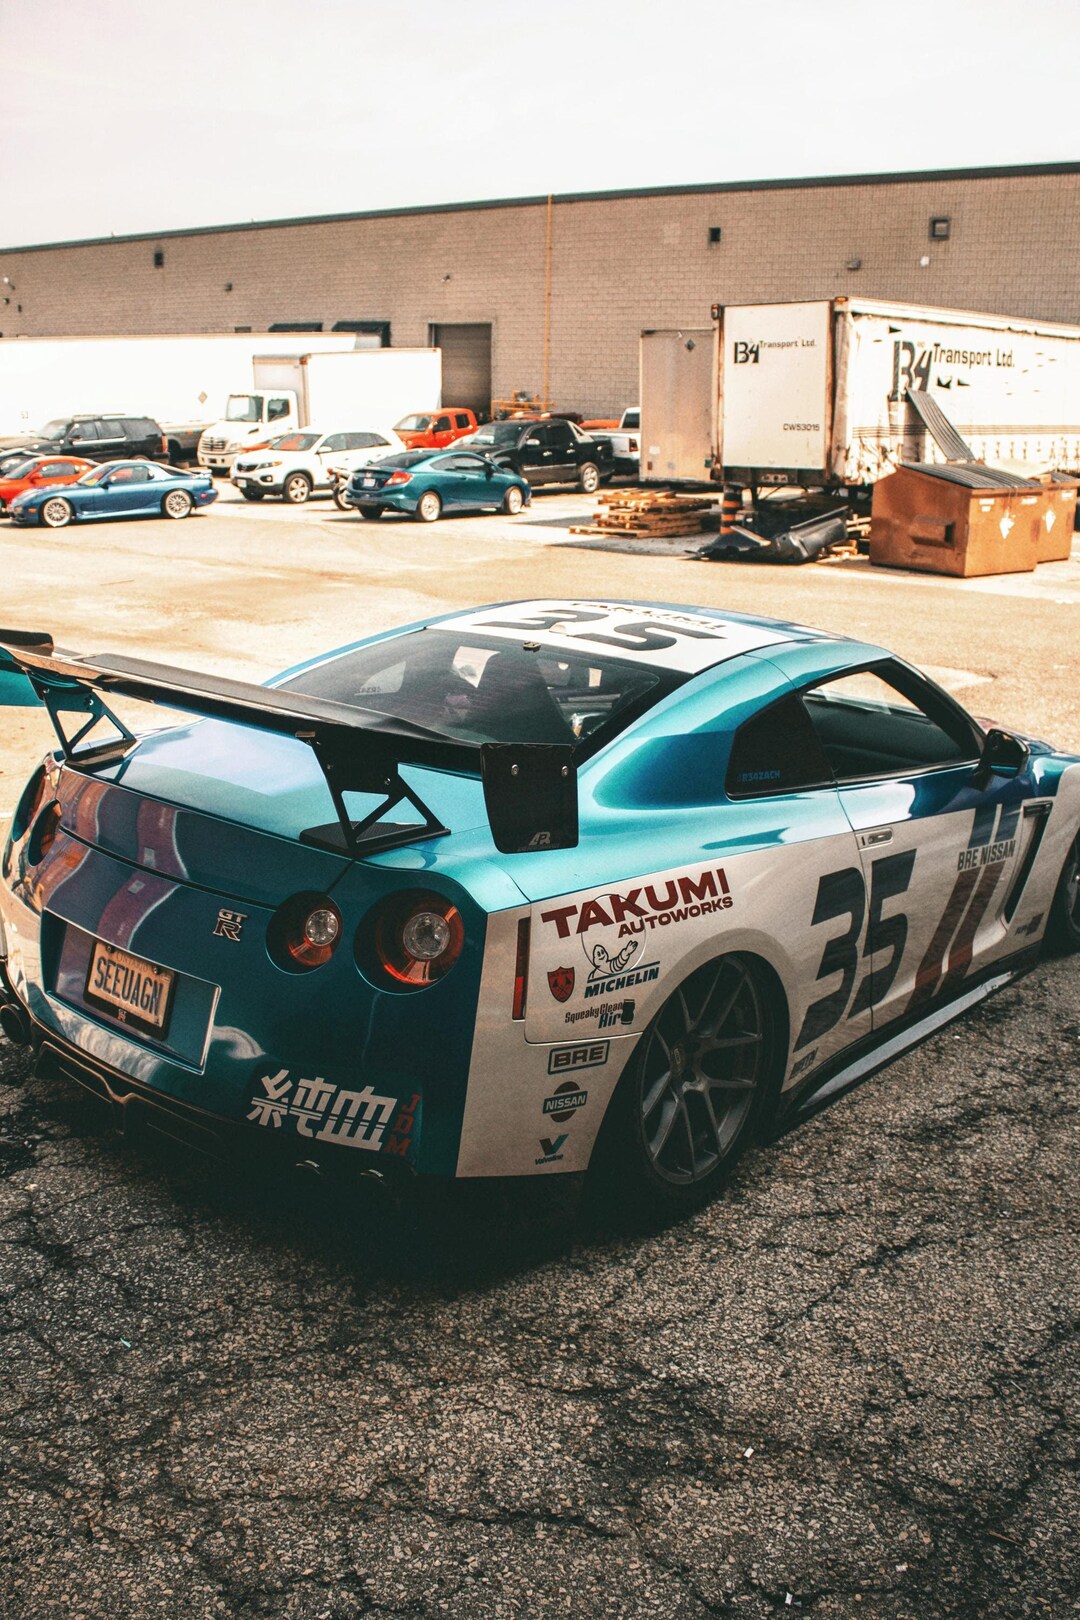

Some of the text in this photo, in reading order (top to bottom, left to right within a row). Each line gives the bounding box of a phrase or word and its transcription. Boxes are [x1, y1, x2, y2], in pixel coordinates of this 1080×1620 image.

[734, 339, 816, 364] B4 Transport Ltd.
[934, 342, 992, 369] Transport
[996, 348, 1015, 368] Ltd.
[957, 839, 1016, 871] BRE NISSAN
[541, 868, 730, 939] TAKUMI
[618, 896, 734, 938] AUTOWORKS
[792, 849, 917, 1053] 35
[94, 956, 164, 1016] SEEUAGN
[584, 967, 660, 998] MICHELIN
[565, 1002, 623, 1024] Squeaky Clean
[553, 1045, 605, 1068] BRE
[246, 1069, 398, 1151] 純血
[545, 1095, 586, 1111] NISSAN
[384, 1094, 422, 1156] JDM
